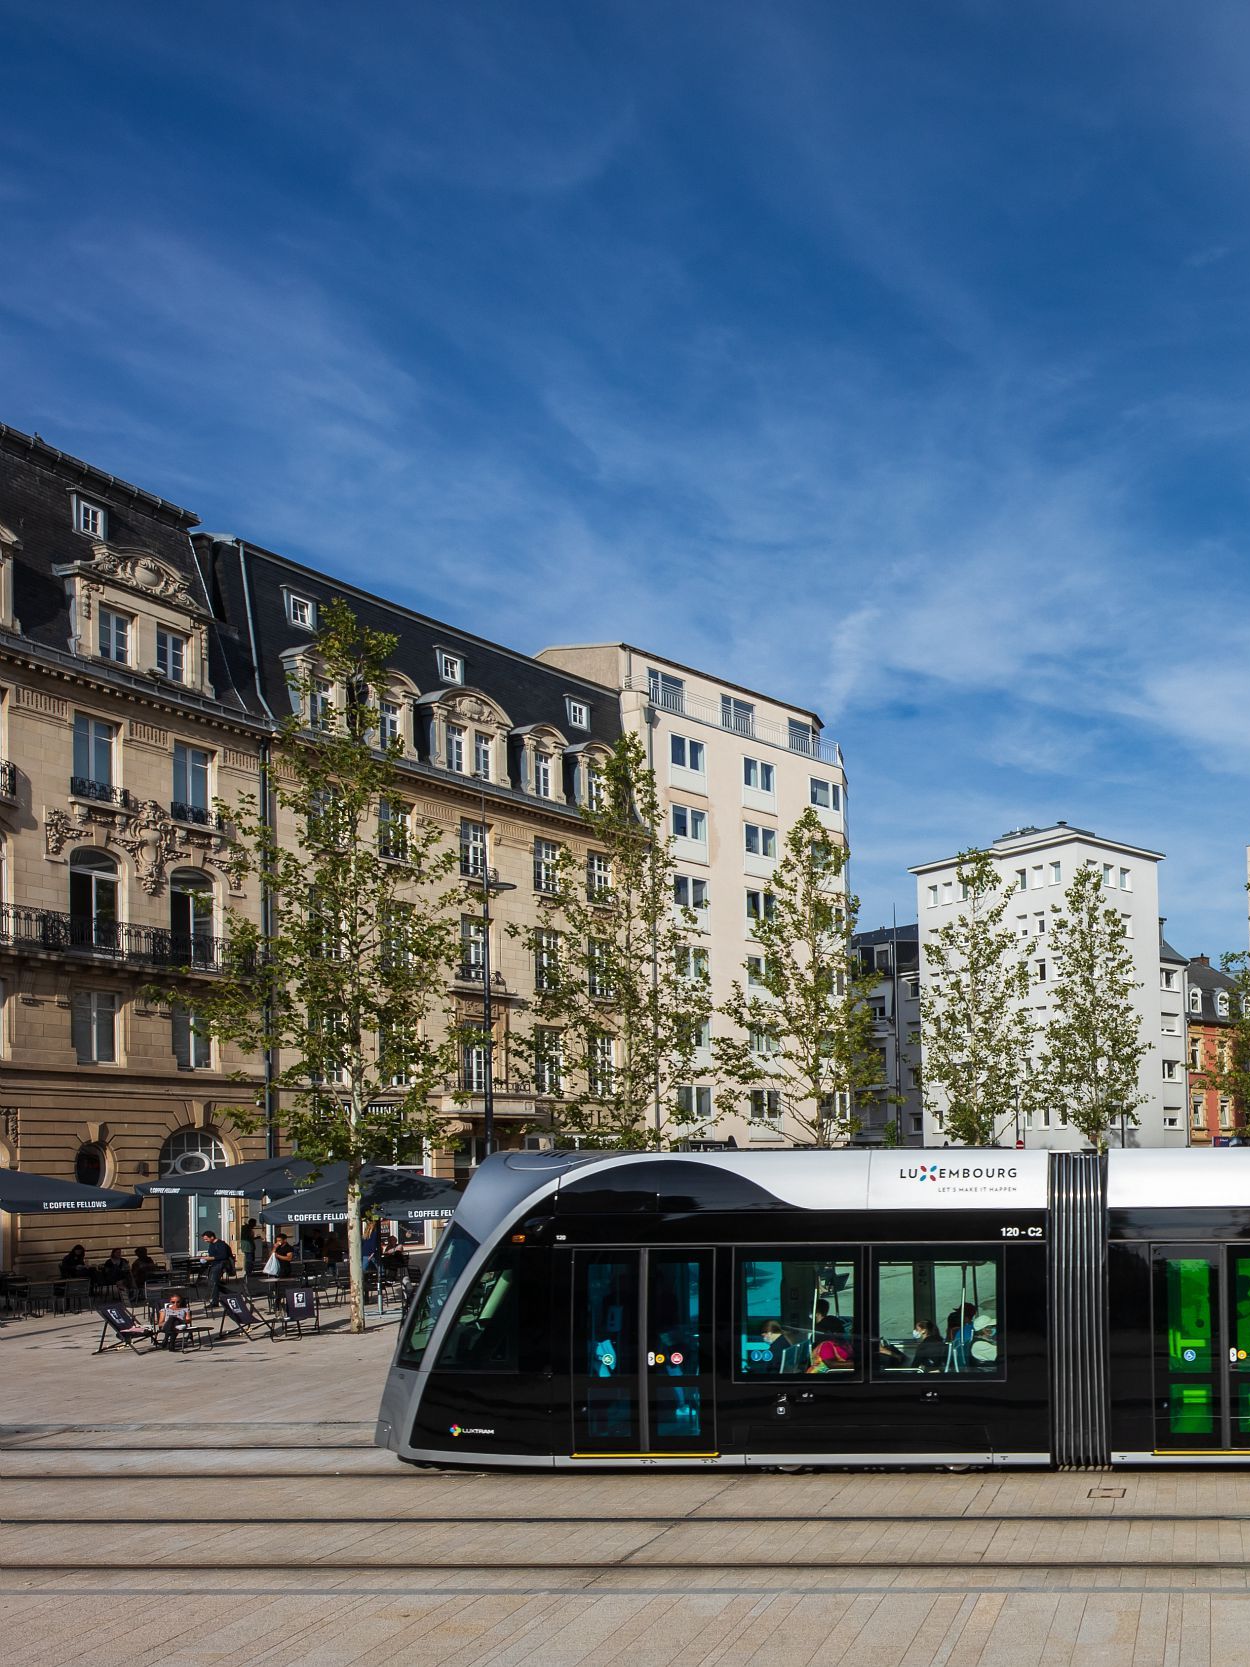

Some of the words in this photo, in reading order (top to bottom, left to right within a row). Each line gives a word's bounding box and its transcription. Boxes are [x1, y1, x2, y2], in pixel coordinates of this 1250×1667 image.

[900, 1165, 1017, 1181] LUXEMBOURG
[76, 1201, 107, 1209] FELLOWS
[294, 1213, 322, 1222] COFFEE
[413, 1210, 440, 1218] COFFEE
[1001, 1228, 1019, 1237] 120
[1028, 1227, 1043, 1237] C2
